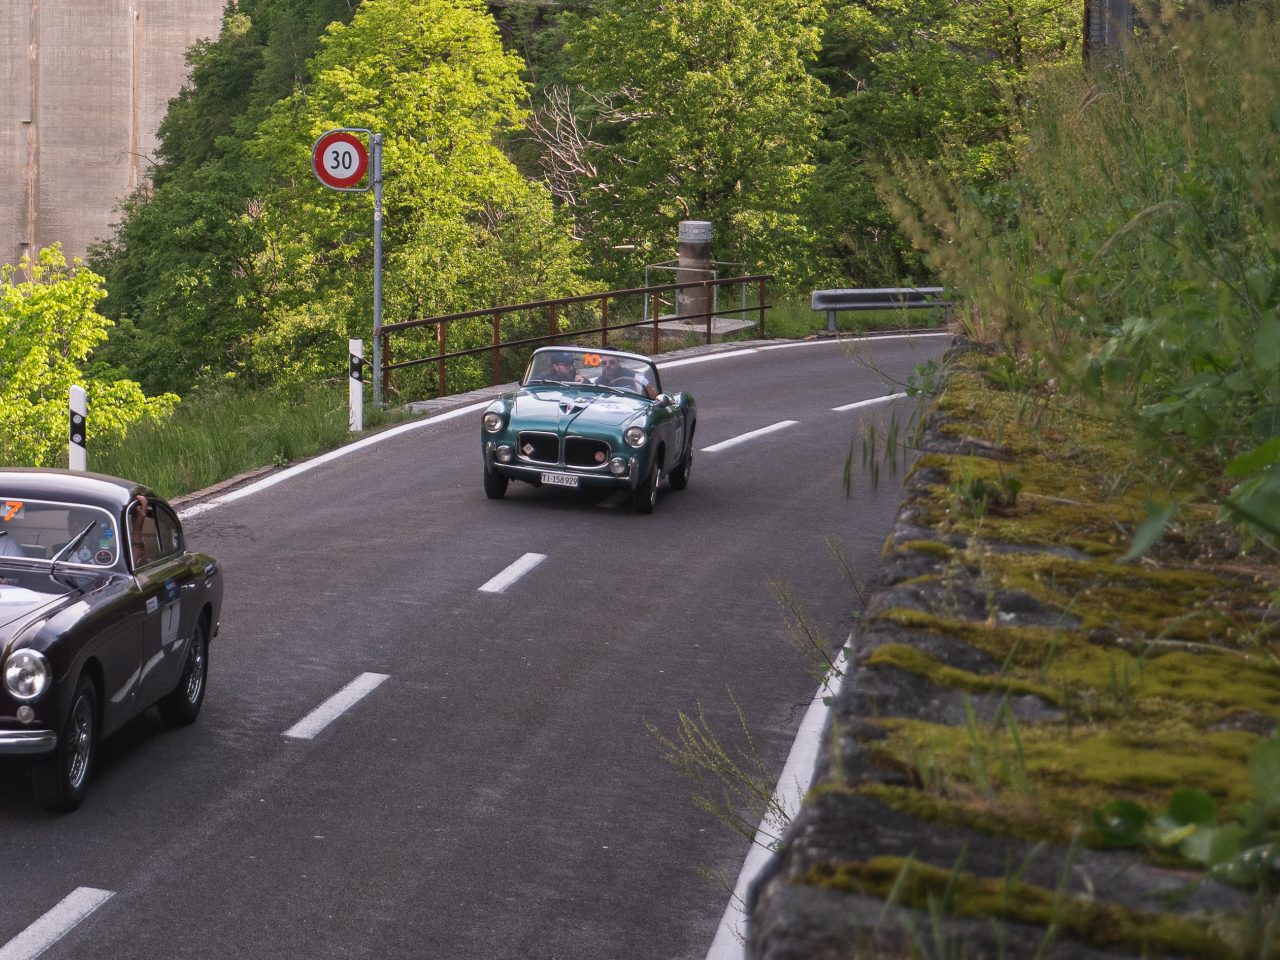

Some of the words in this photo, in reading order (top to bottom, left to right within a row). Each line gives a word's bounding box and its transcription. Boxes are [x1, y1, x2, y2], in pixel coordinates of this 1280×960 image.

[331, 151, 352, 169] 30
[584, 353, 600, 367] 10
[4, 501, 24, 521] 7
